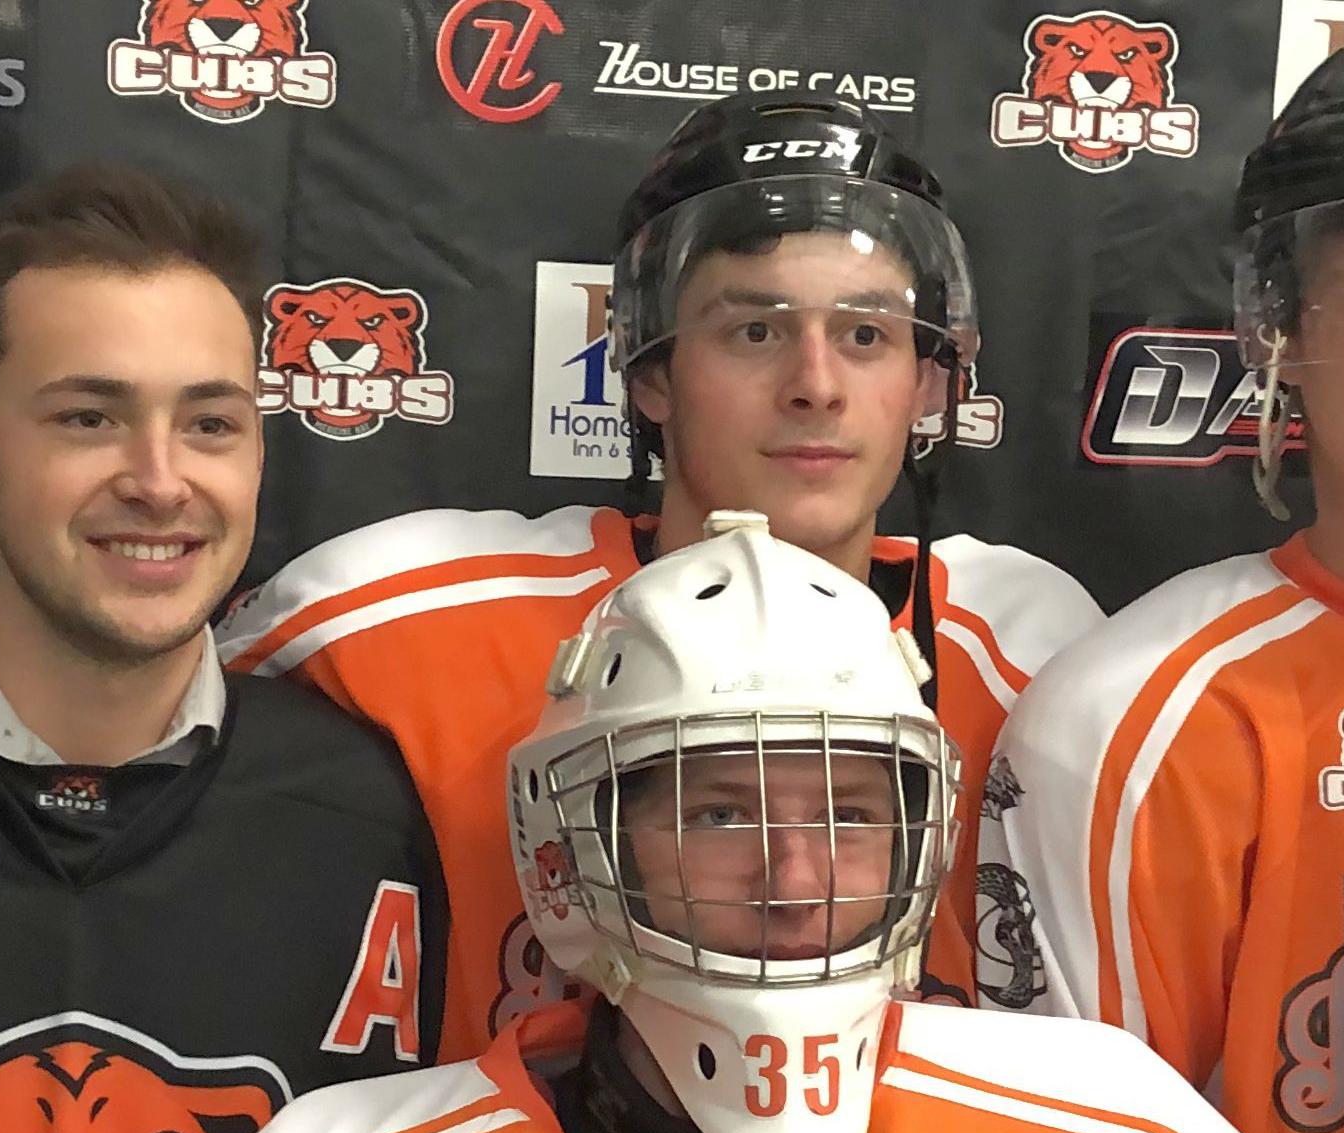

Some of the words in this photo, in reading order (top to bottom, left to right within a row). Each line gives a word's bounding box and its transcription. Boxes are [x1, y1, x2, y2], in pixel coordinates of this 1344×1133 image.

[111, 42, 333, 106] CUBS
[596, 41, 738, 92] HOUSE
[994, 95, 1196, 156] CUBS
[320, 879, 422, 1063] A
[744, 1033, 840, 1118] 35
